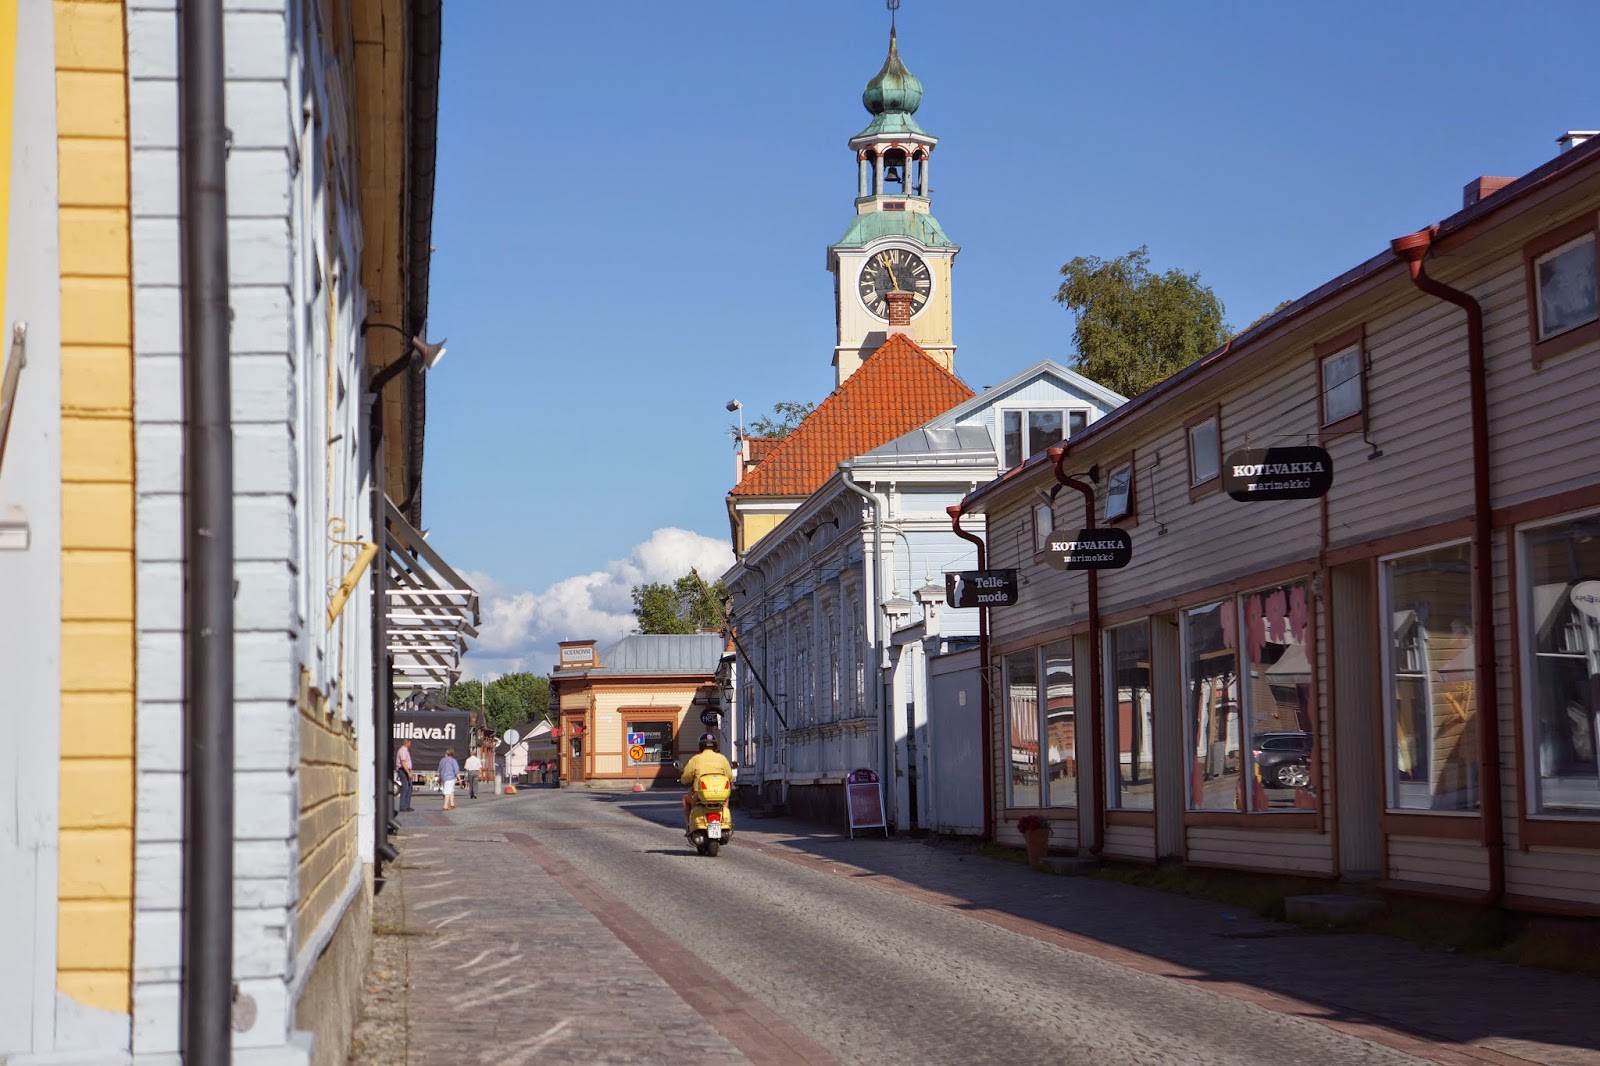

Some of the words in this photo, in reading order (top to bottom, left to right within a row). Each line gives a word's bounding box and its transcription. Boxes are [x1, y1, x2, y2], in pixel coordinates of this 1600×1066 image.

[1232, 462, 1325, 477] KOTI-VAKKA
[1247, 479, 1311, 491] marimekko
[1051, 540, 1125, 552] KOTI-VAKKA
[1063, 554, 1114, 563] marimekko
[975, 577, 1009, 588] Telle-
[977, 591, 1009, 603] mode
[393, 722, 456, 740] iililava.fi
